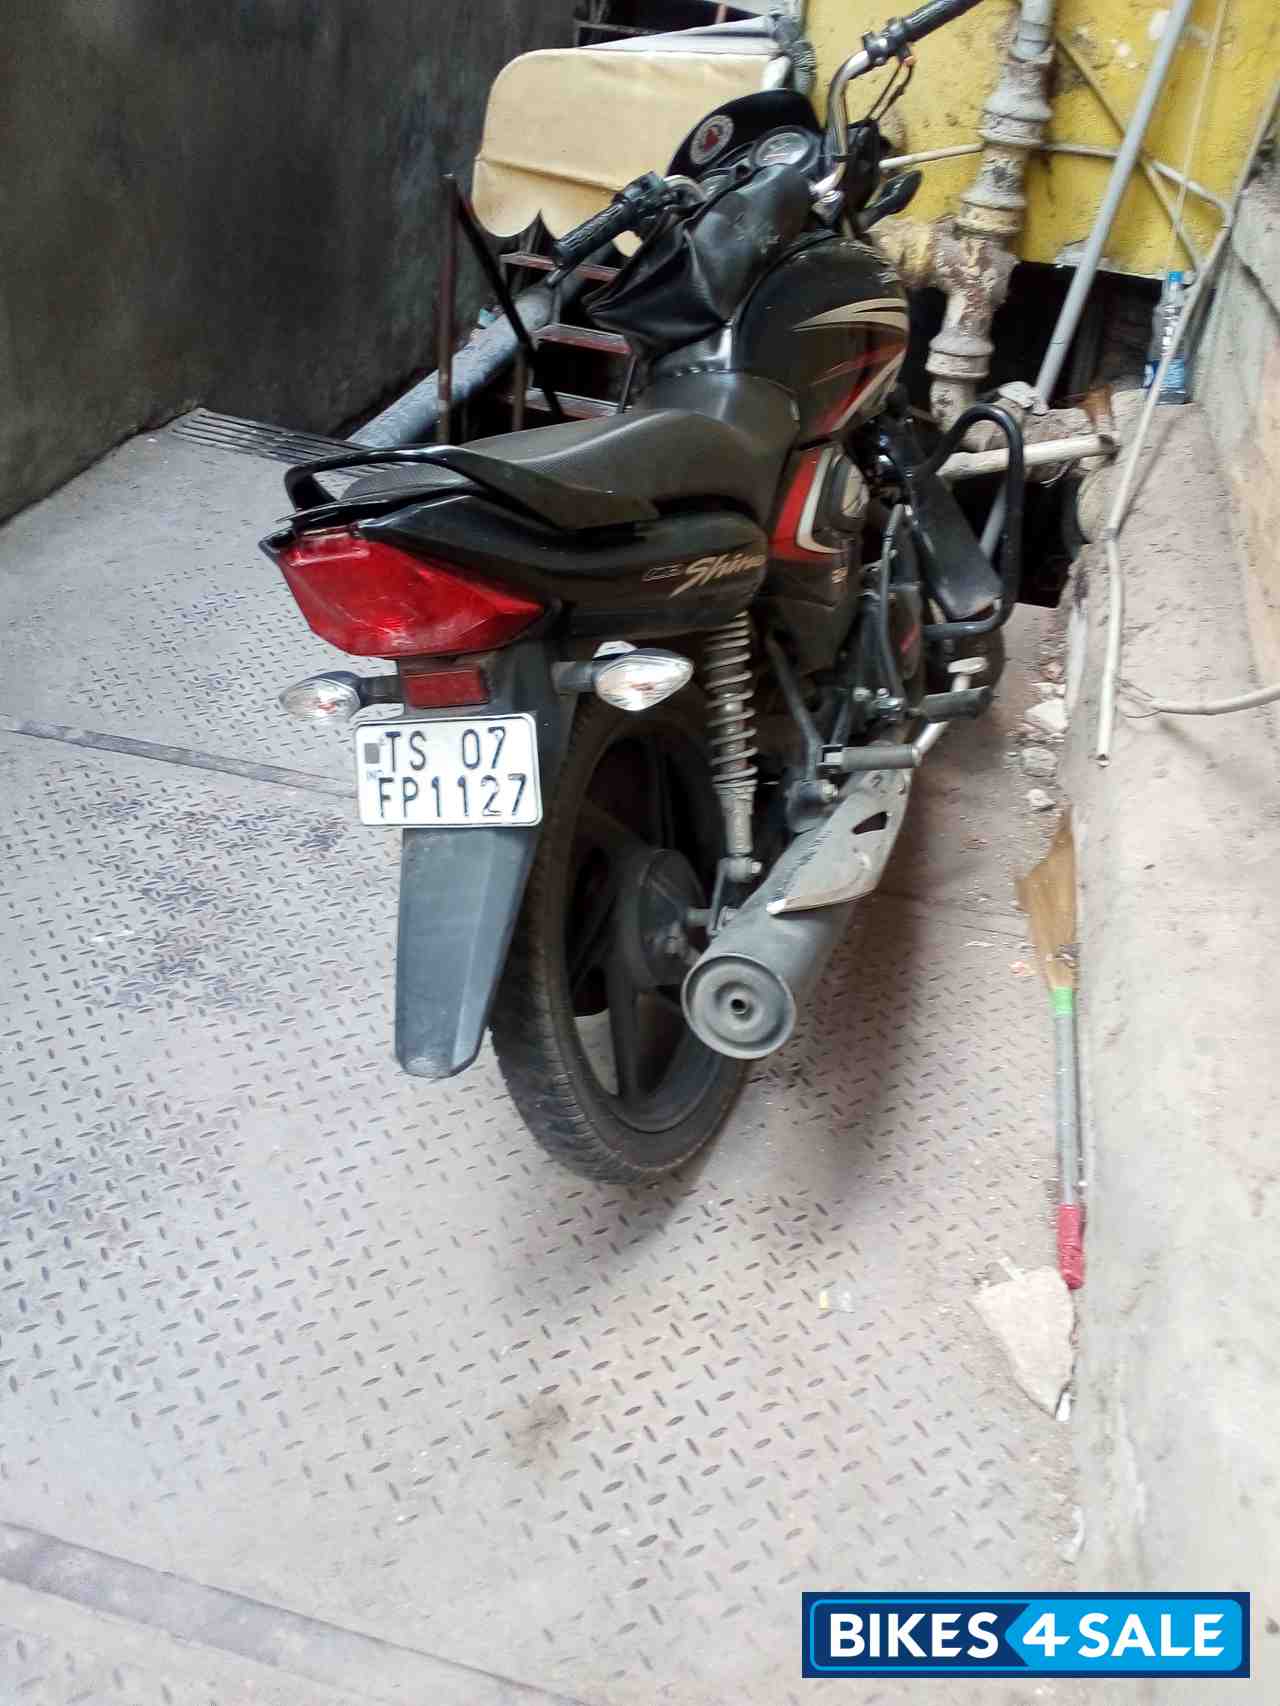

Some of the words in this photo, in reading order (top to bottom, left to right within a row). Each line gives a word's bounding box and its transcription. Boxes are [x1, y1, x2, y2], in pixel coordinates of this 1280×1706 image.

[384, 730, 427, 772] TS
[462, 726, 506, 769] 07
[378, 773, 527, 818] FP1127
